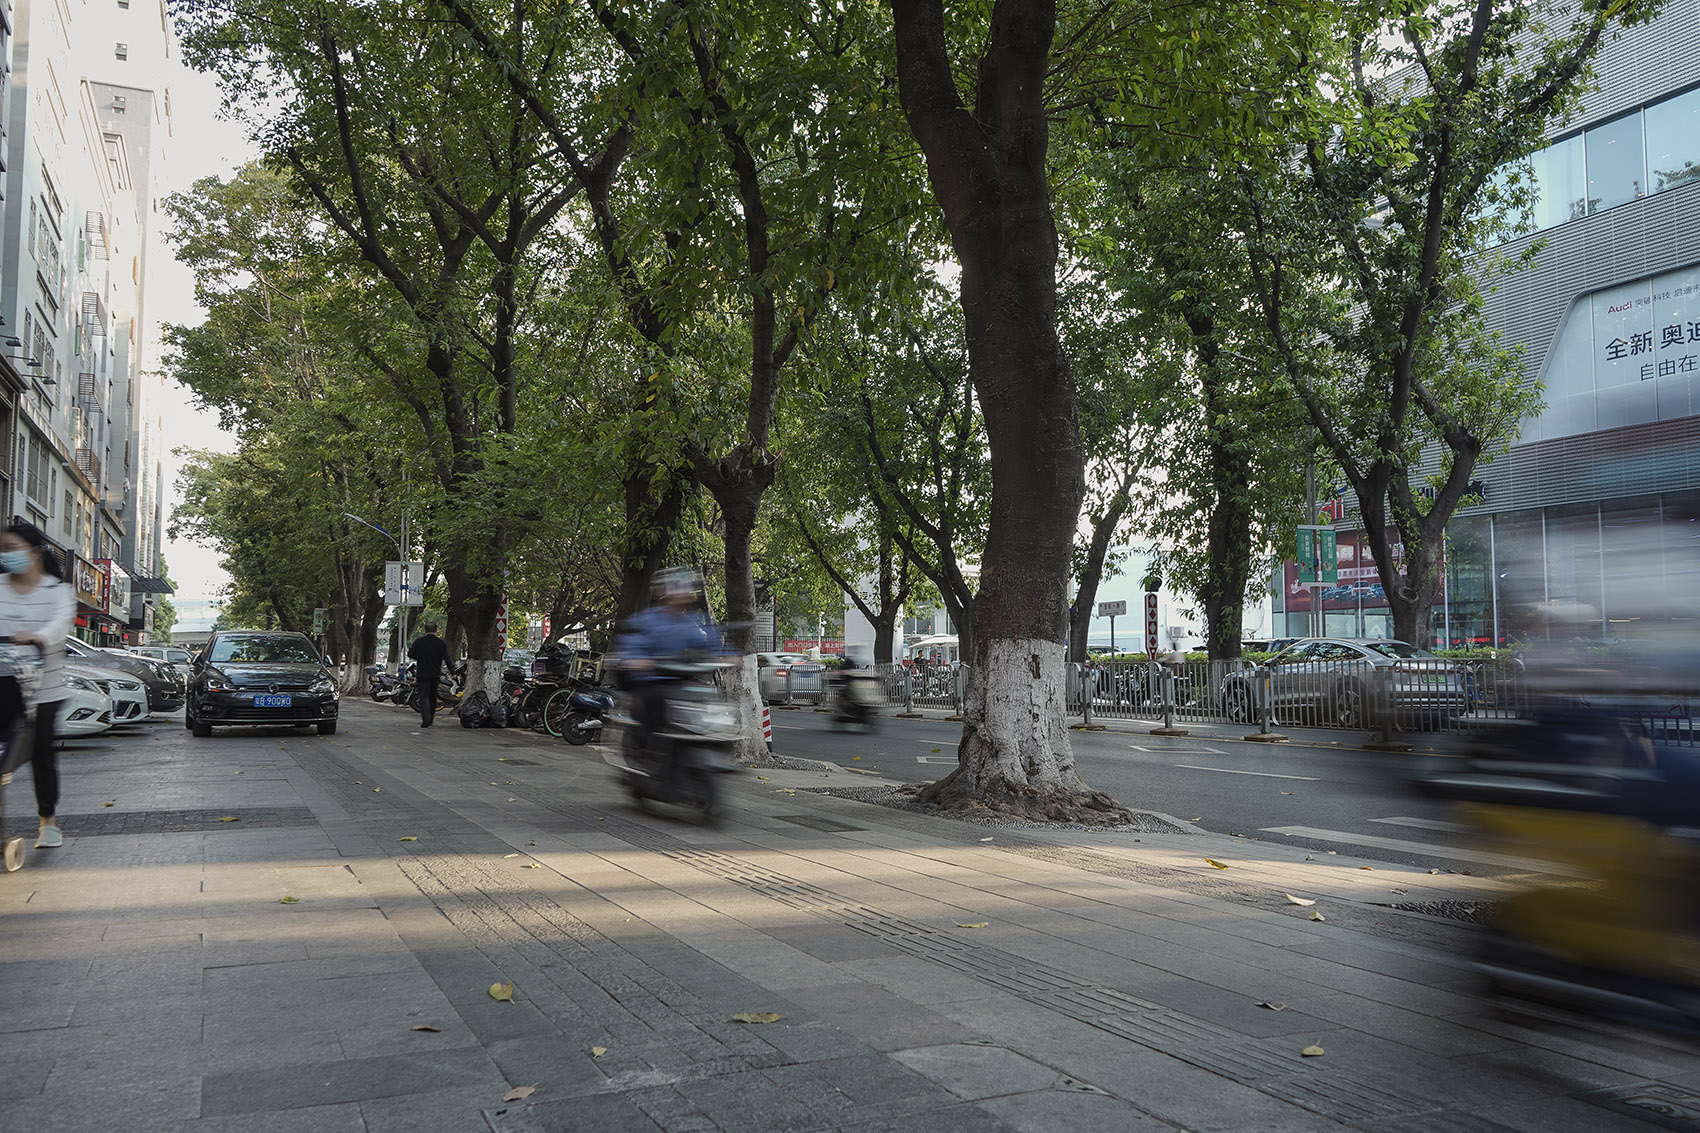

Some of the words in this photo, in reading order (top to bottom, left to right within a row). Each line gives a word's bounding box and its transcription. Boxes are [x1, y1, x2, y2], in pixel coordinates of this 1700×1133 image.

[1608, 301, 1632, 314] Audi
[1635, 292, 1671, 307] 突破科技
[1605, 330, 1653, 361] 全新
[1640, 354, 1698, 381] 自由在
